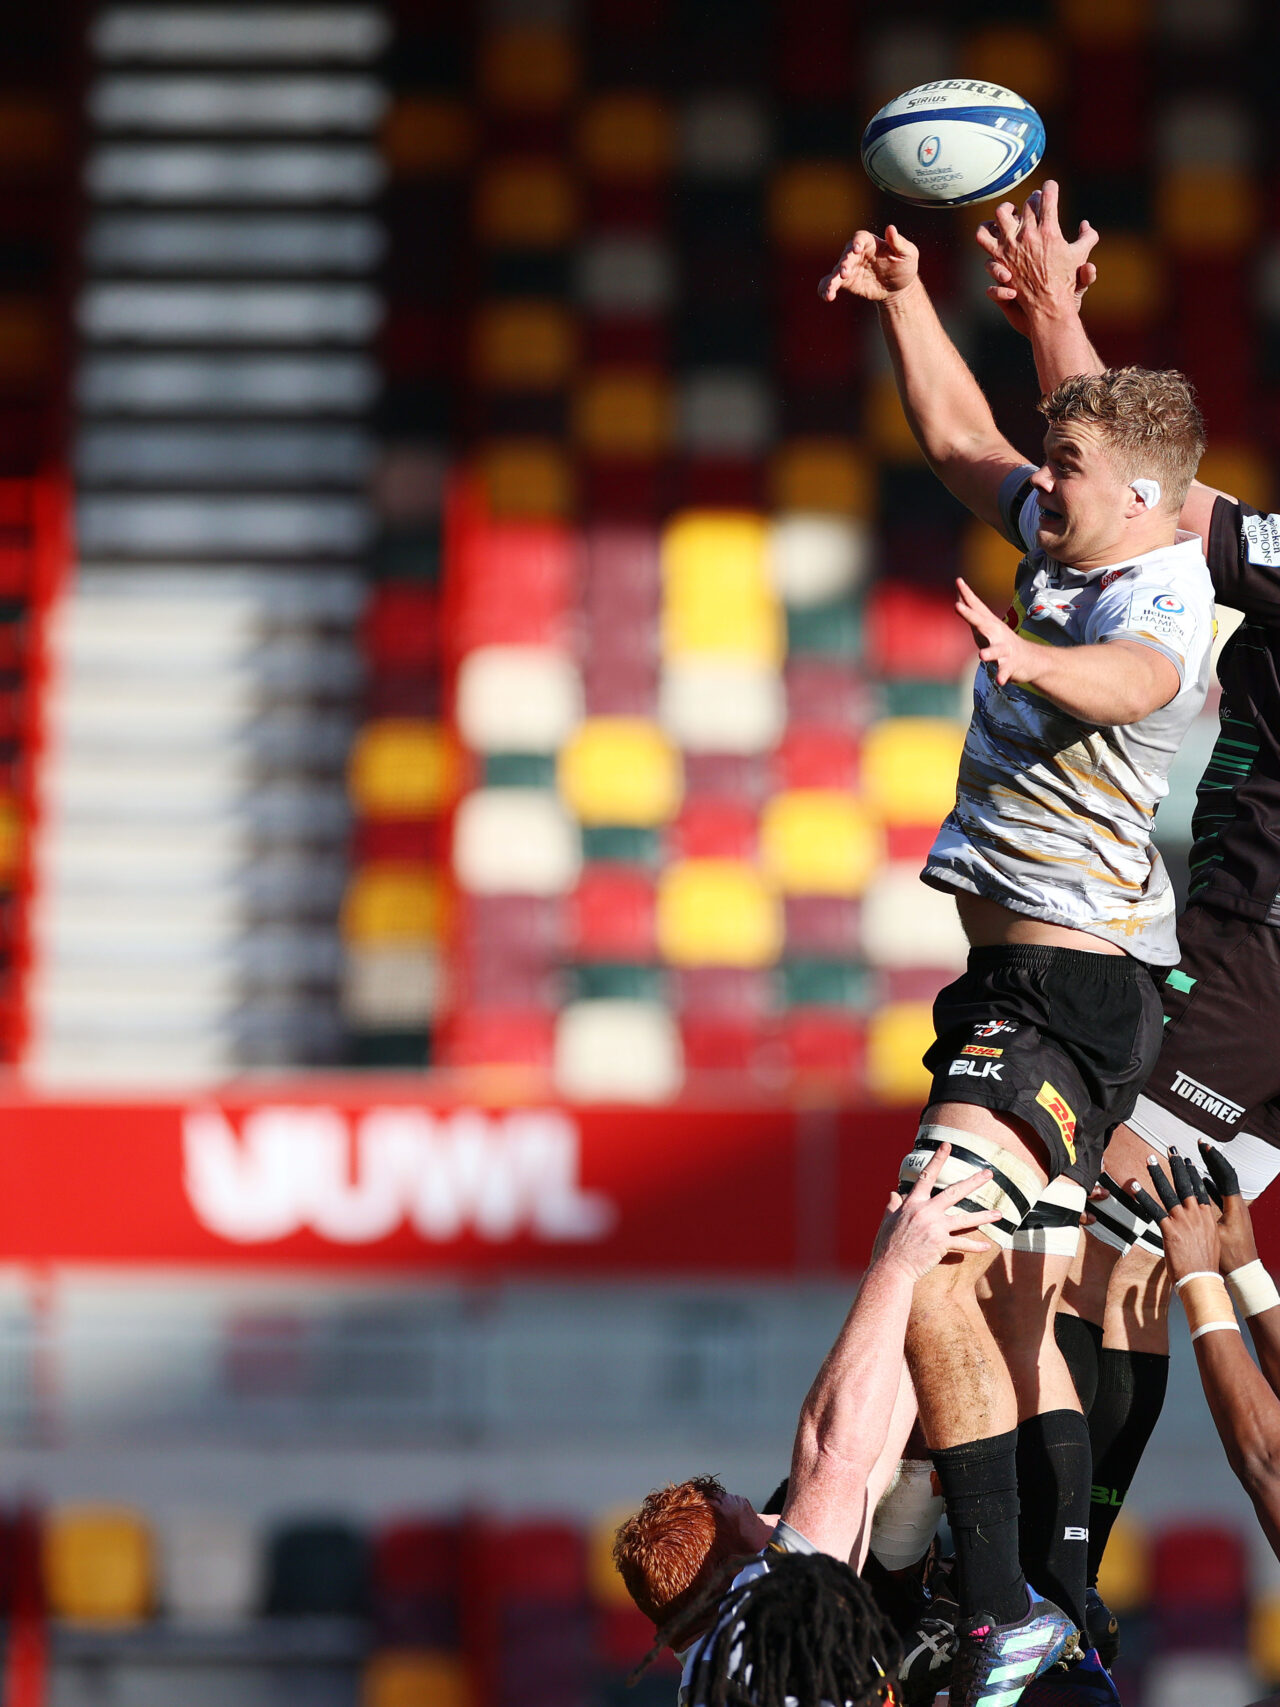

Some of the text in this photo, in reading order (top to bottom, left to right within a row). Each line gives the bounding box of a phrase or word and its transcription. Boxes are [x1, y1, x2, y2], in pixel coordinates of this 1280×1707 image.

[1246, 524, 1258, 544] CUP
[1258, 517, 1273, 564] AMPIONS
[949, 1059, 1005, 1081] BLK
[1169, 1069, 1246, 1126] TURMEC
